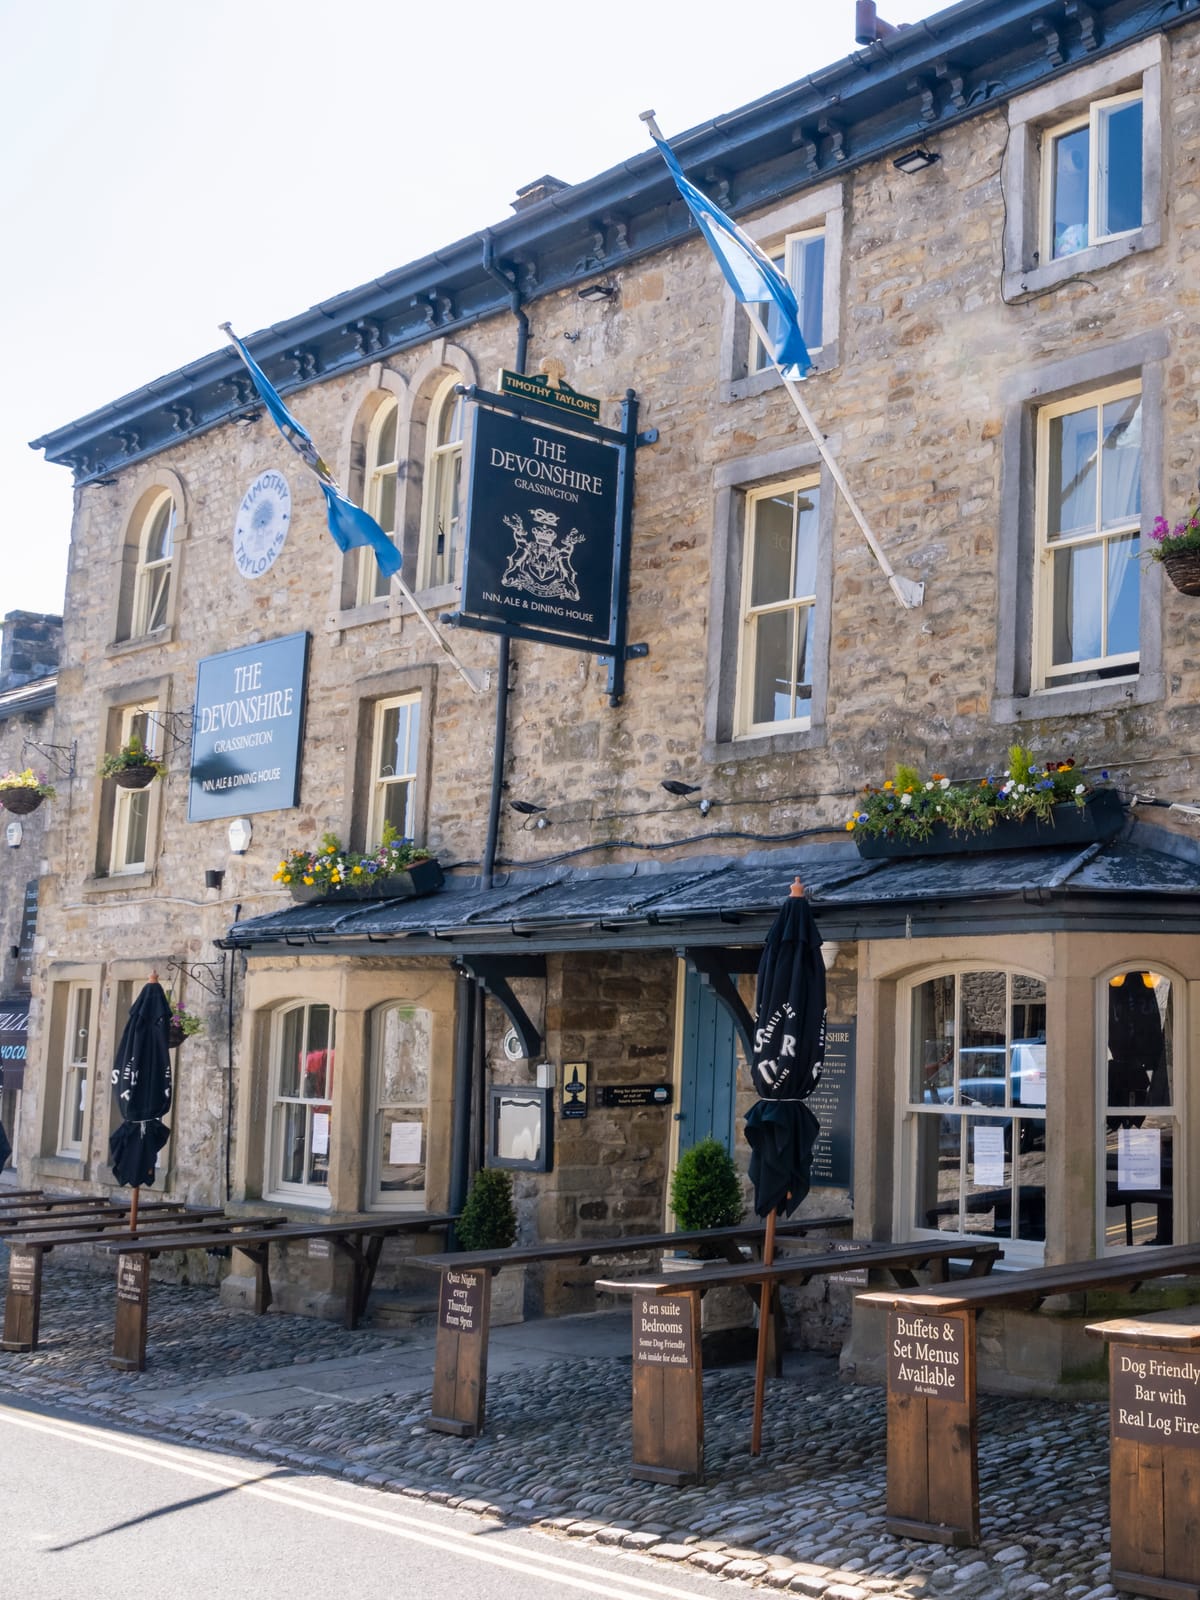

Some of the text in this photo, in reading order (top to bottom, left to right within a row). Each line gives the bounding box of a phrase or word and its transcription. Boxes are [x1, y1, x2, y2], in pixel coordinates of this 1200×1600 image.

[506, 377, 598, 412] TIMOTHY TAYLOR'S
[533, 437, 566, 463] THE
[490, 448, 603, 495] DEVONSHIRE
[241, 474, 288, 512] TIMOTHY
[514, 478, 579, 503] GRASSINGTON
[236, 532, 284, 574] TAYLOR'S
[504, 596, 520, 607] ALE
[522, 600, 529, 609] &
[531, 601, 564, 616] DINING
[565, 609, 594, 622] HOUSE
[234, 662, 262, 694] THE
[200, 688, 293, 734] DEVONSHIRE
[214, 730, 273, 754] GRASSINGTON
[215, 776, 227, 789] ALE
[227, 775, 233, 788] &
[234, 771, 256, 786] DINING
[258, 768, 281, 783] HOUSE
[762, 1010, 782, 1044] FAMILY
[447, 1271, 477, 1288] Quiz Night
[448, 1299, 473, 1317] Thursday
[453, 1289, 468, 1302] every
[446, 1312, 473, 1330] from 9pm
[642, 1301, 680, 1316] 8 en suite
[641, 1318, 683, 1334] Bedrooms
[897, 1317, 955, 1341] Buffets &
[638, 1351, 688, 1363] Ask inside for details
[639, 1338, 686, 1351] Some Dog Friendly
[893, 1339, 959, 1365] Set Menus
[897, 1362, 955, 1387] Available
[1121, 1356, 1200, 1384] Dog Friendly
[914, 1385, 938, 1395] Ask within
[1135, 1384, 1187, 1406] Bar with
[1119, 1408, 1144, 1427] Real
[1148, 1412, 1171, 1435] Log
